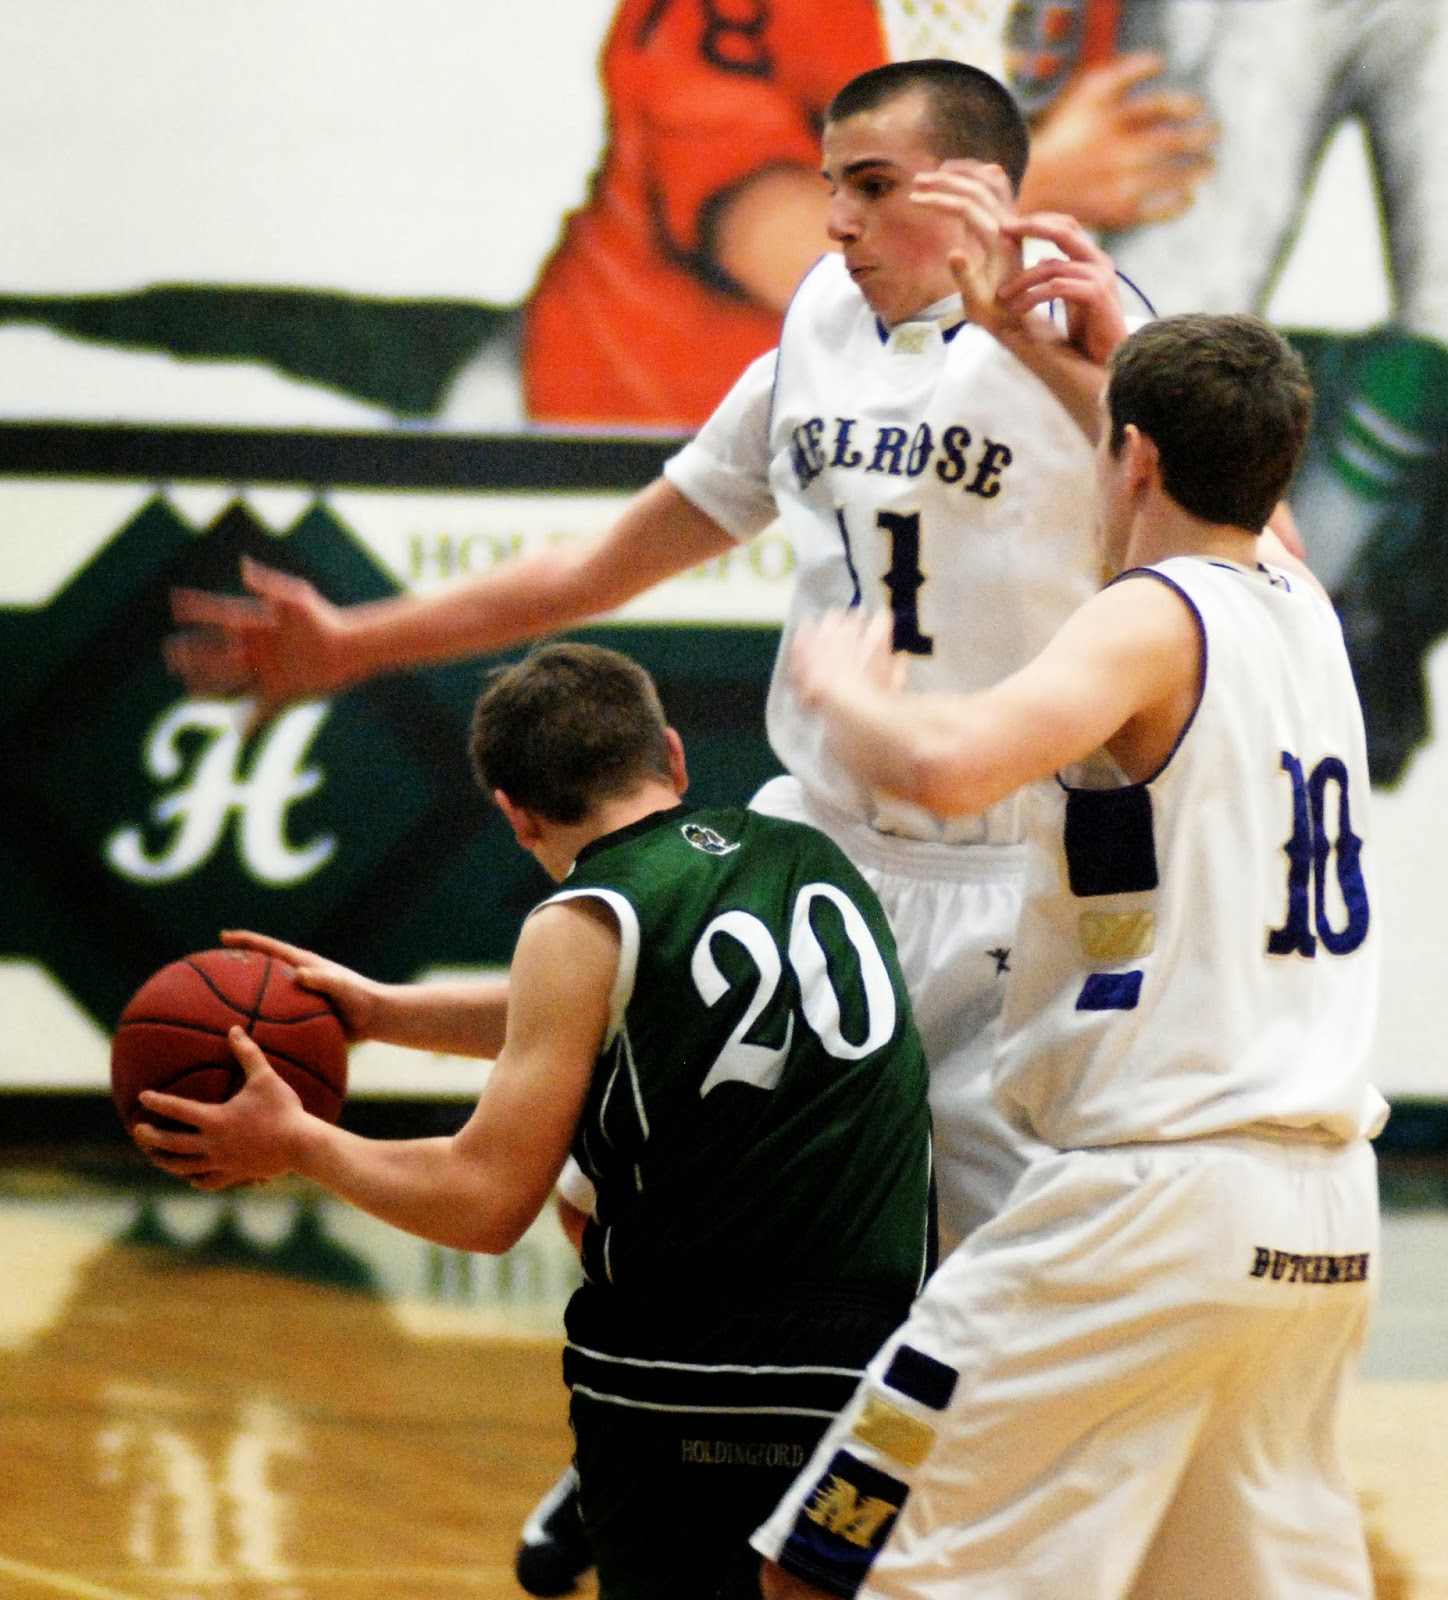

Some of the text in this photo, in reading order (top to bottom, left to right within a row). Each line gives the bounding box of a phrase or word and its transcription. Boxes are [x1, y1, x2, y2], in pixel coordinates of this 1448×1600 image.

[102, 696, 336, 886] H
[1263, 748, 1371, 960] 10
[690, 881, 897, 1100] 20
[680, 1438, 805, 1468] HOLDINGFORD
